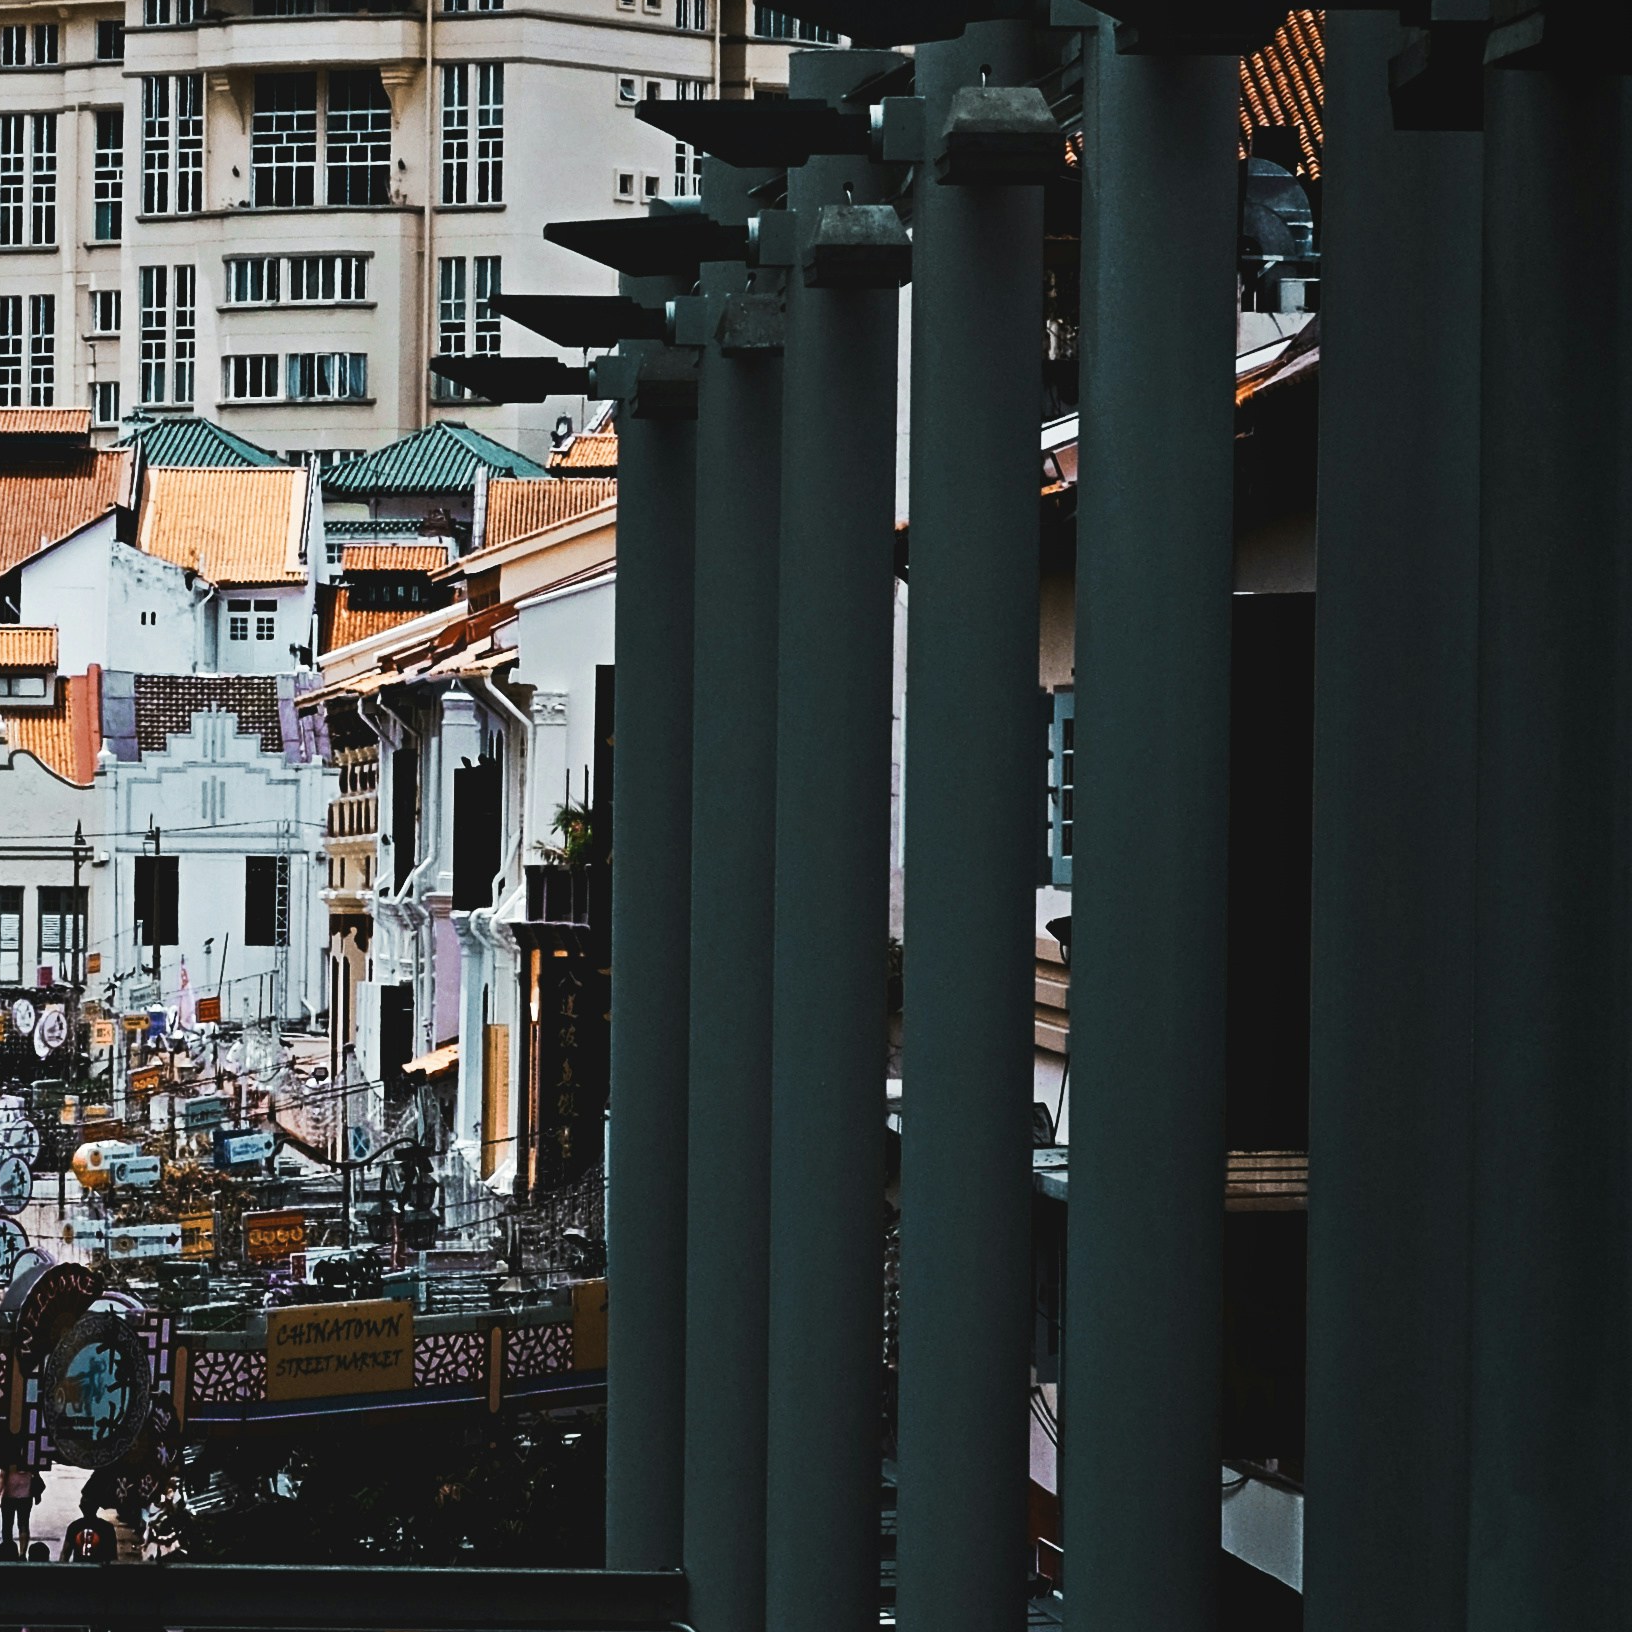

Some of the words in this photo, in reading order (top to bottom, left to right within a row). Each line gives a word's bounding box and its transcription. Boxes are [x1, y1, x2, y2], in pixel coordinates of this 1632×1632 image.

[276, 1313, 404, 1346] CHINATOWN
[275, 1354, 335, 1378] STREET
[335, 1349, 404, 1373] MARKET
